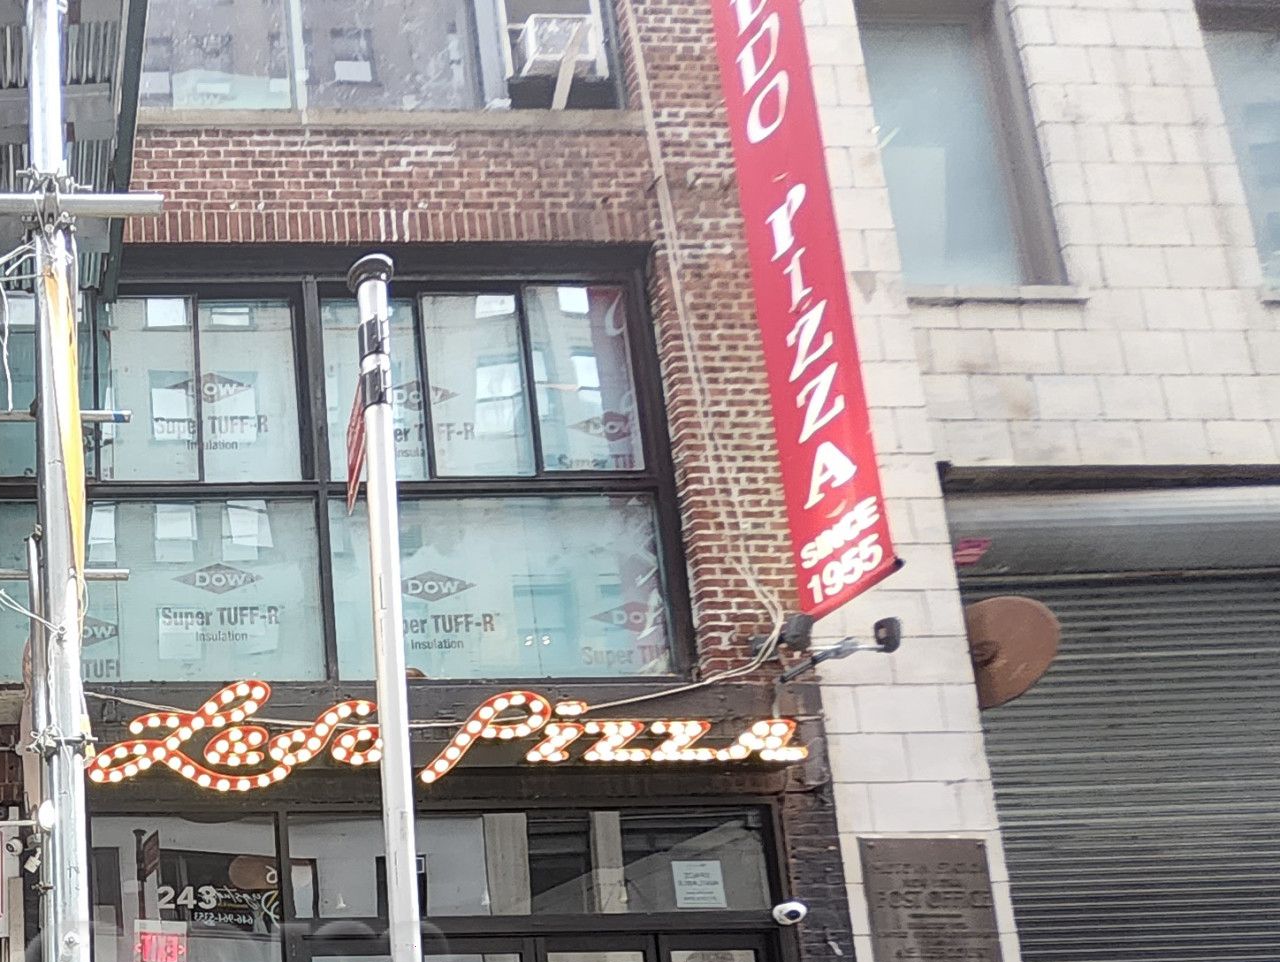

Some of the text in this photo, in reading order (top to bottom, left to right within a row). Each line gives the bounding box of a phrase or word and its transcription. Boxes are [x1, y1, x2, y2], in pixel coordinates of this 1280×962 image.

[765, 183, 858, 509] PIZZA
[800, 496, 880, 569] SINCE
[195, 571, 246, 587] DOW
[807, 533, 883, 604] 1955
[407, 579, 461, 594] DOW
[161, 607, 213, 630] Super
[195, 630, 248, 642] Insulation
[410, 638, 465, 651] Insulation
[88, 680, 808, 790] Ledo Pizza
[157, 885, 218, 910] 243
